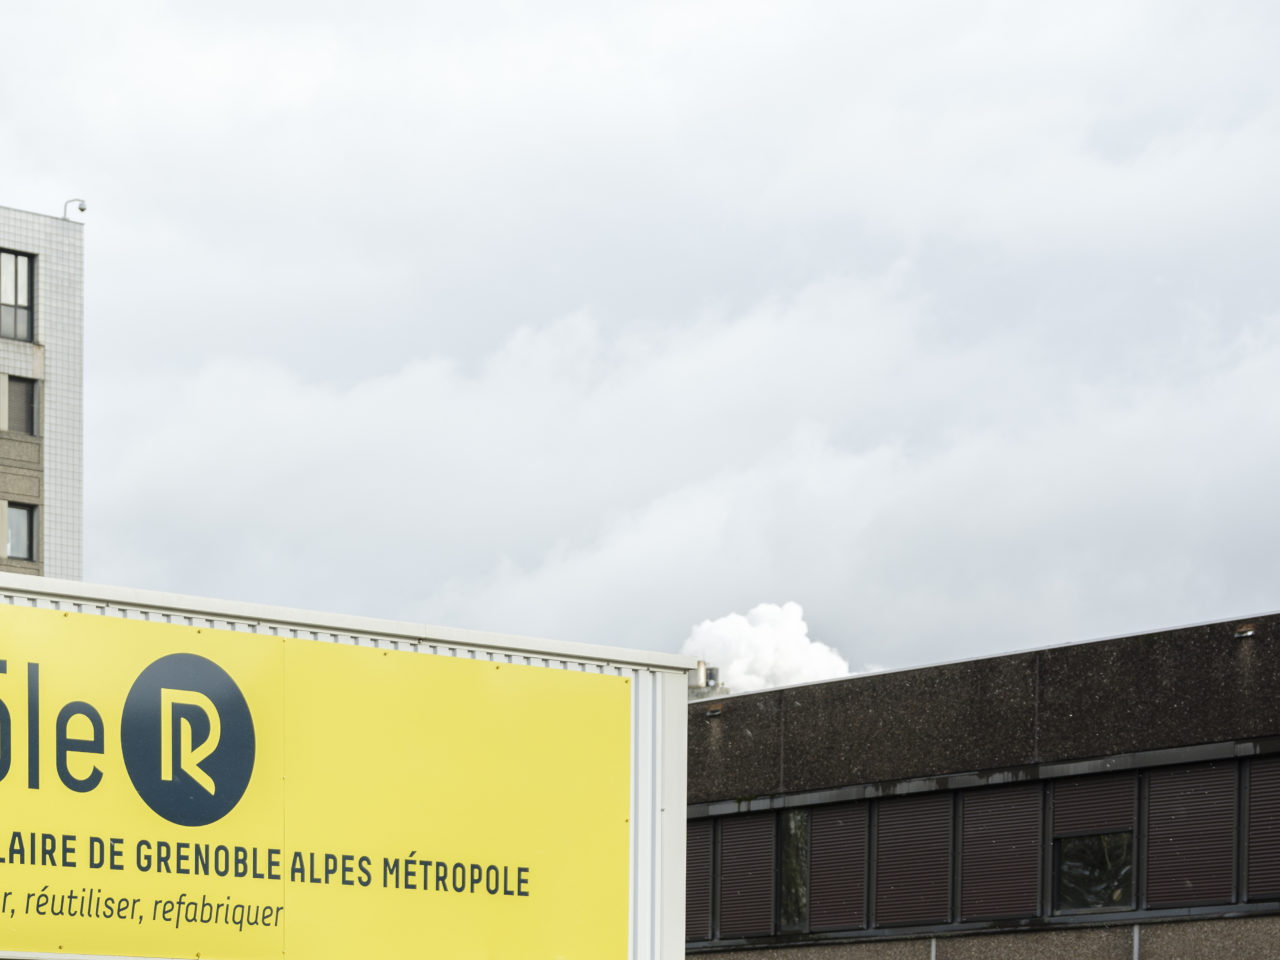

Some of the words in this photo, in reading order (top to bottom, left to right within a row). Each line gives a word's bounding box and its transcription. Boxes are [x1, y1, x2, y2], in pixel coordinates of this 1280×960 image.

[89, 836, 125, 872] DE
[136, 839, 281, 881] GRENOBLE
[290, 850, 372, 887] ALPES
[382, 850, 530, 897] MÉTROPOLE
[25, 886, 144, 923] réutiliser,
[152, 893, 284, 931] refabriquer
